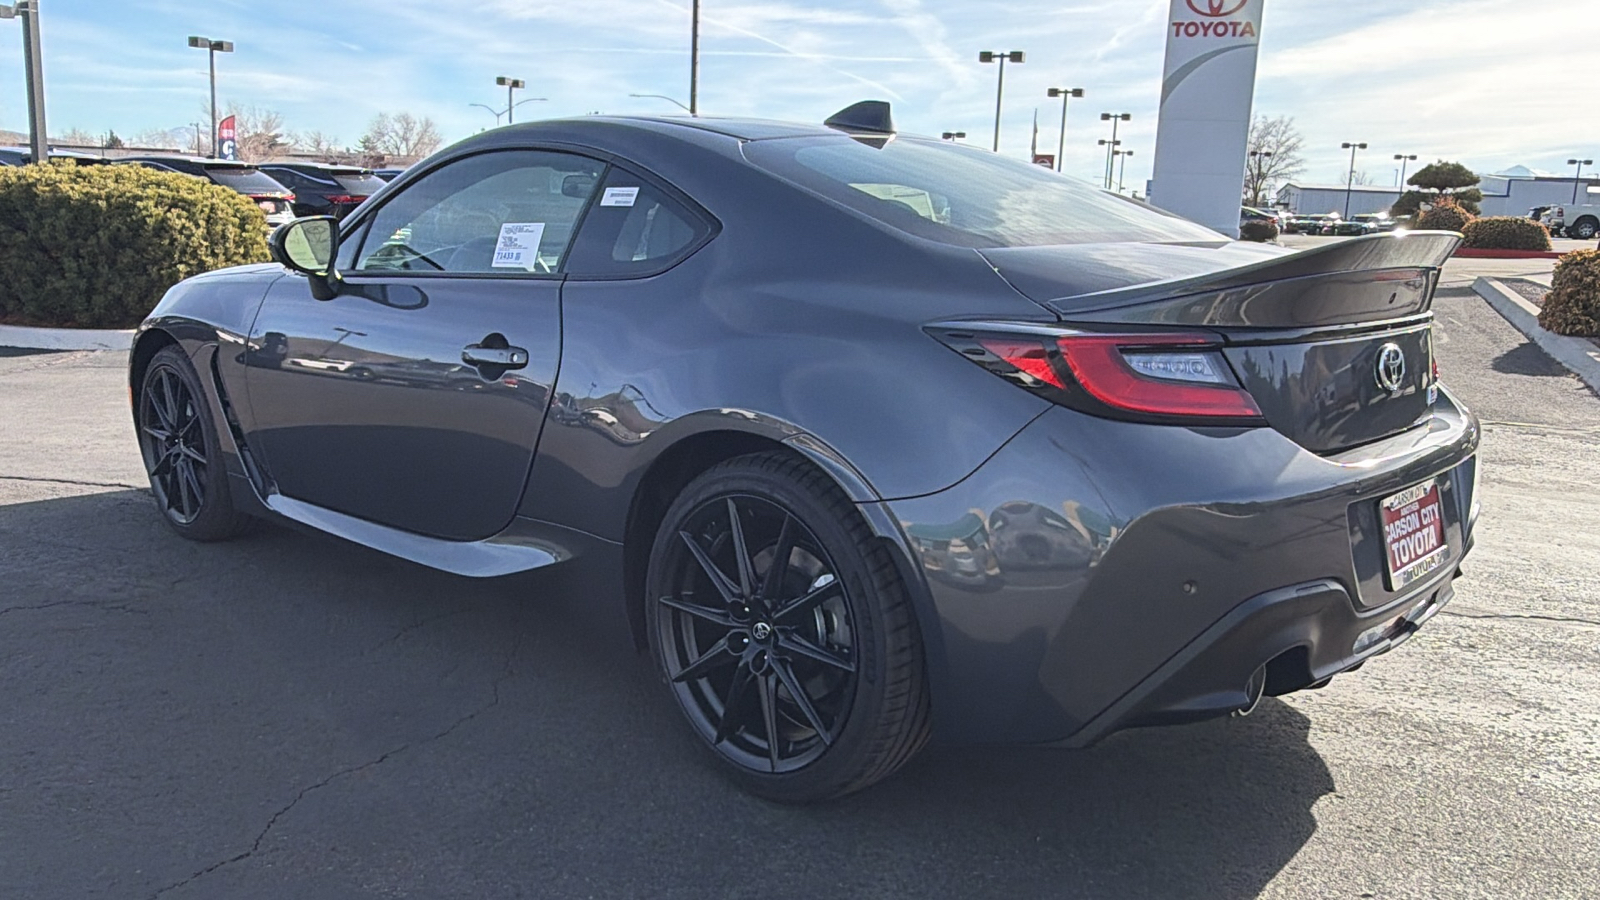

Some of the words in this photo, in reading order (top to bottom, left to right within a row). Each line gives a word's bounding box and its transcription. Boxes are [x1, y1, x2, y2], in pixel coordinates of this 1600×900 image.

[1172, 21, 1255, 37] TOYOTA
[1385, 512, 1420, 543] CARSON
[1421, 502, 1439, 525] CITY
[1392, 525, 1437, 567] TOYOTA
[1408, 556, 1437, 578] TOYOTA
